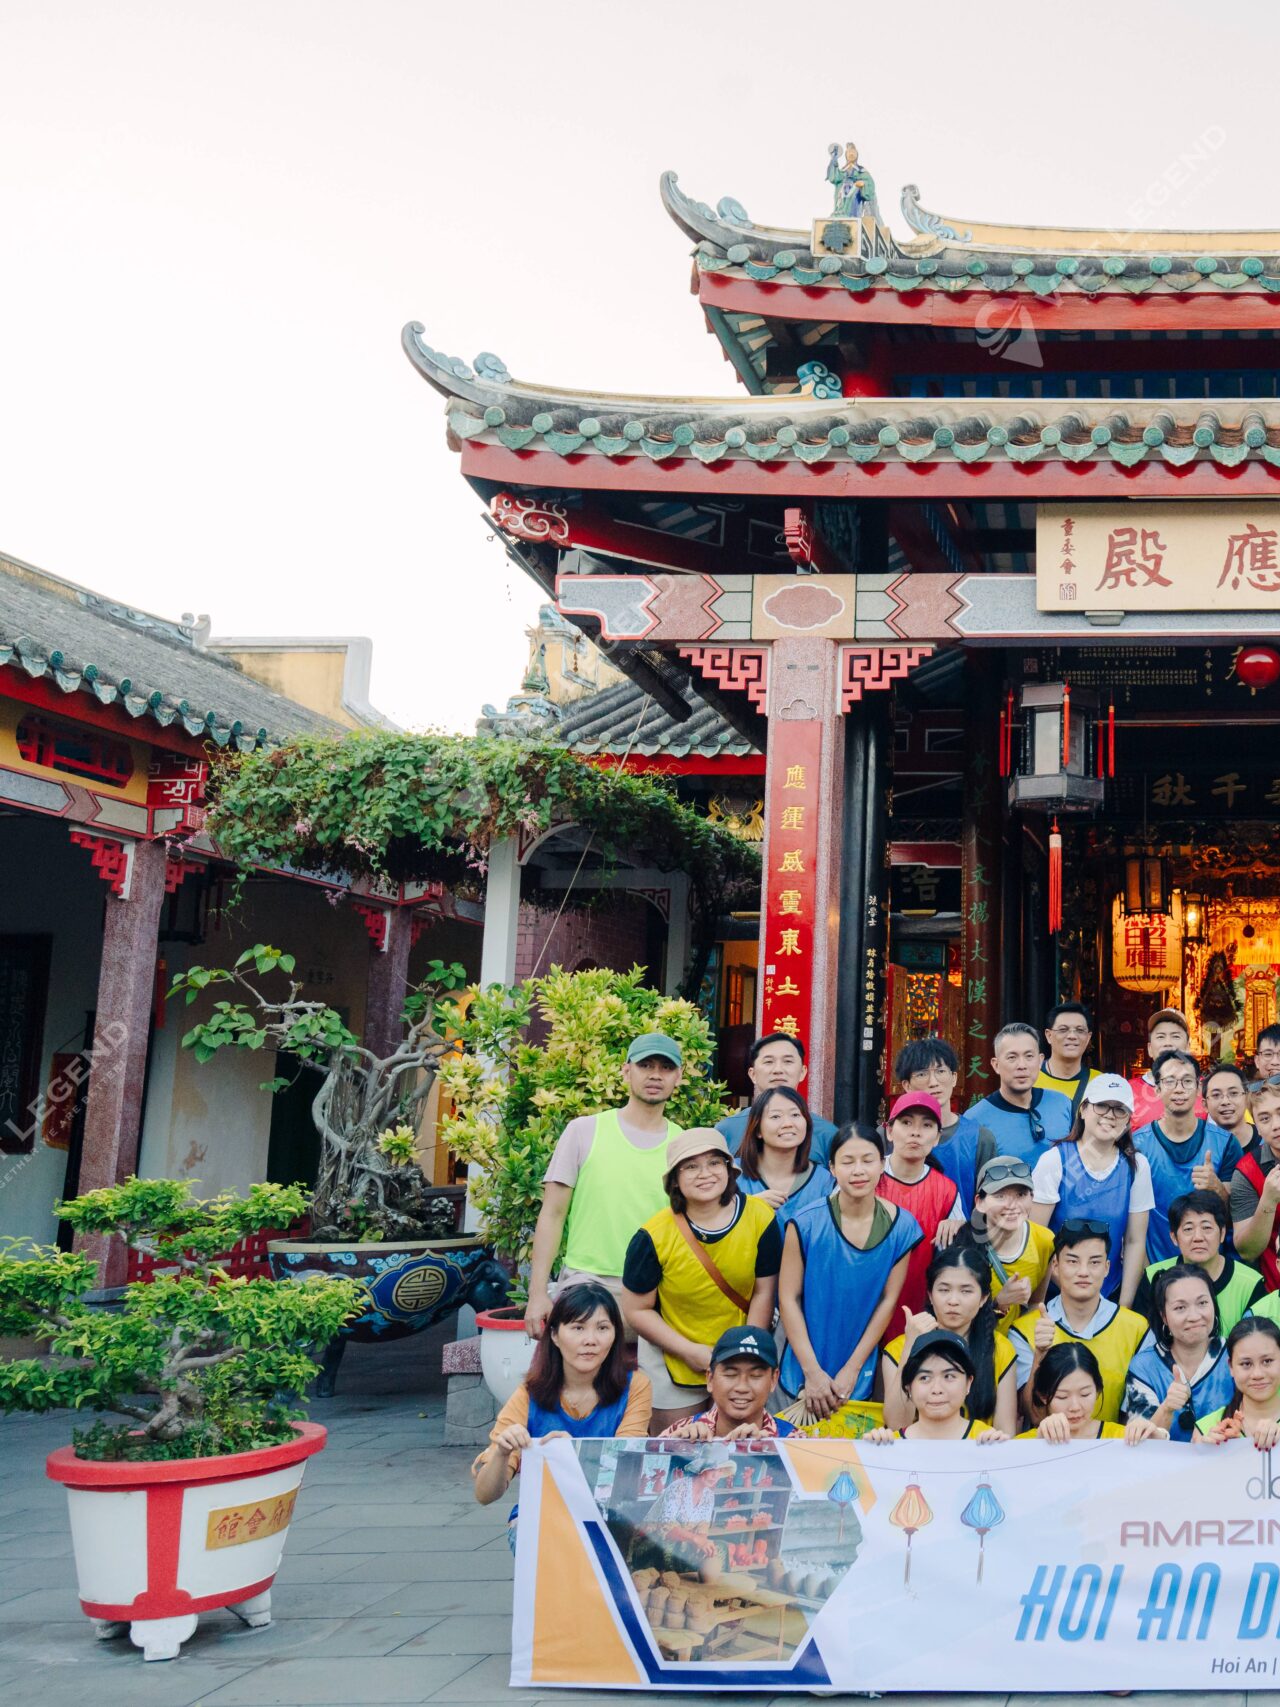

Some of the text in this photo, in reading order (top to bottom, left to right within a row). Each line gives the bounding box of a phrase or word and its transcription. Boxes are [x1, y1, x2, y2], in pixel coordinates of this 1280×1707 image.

[1015, 1564, 1125, 1642] HOI
[1137, 1561, 1221, 1641] AN
[1211, 1657, 1242, 1674] Hoi
[1244, 1657, 1268, 1673] An
